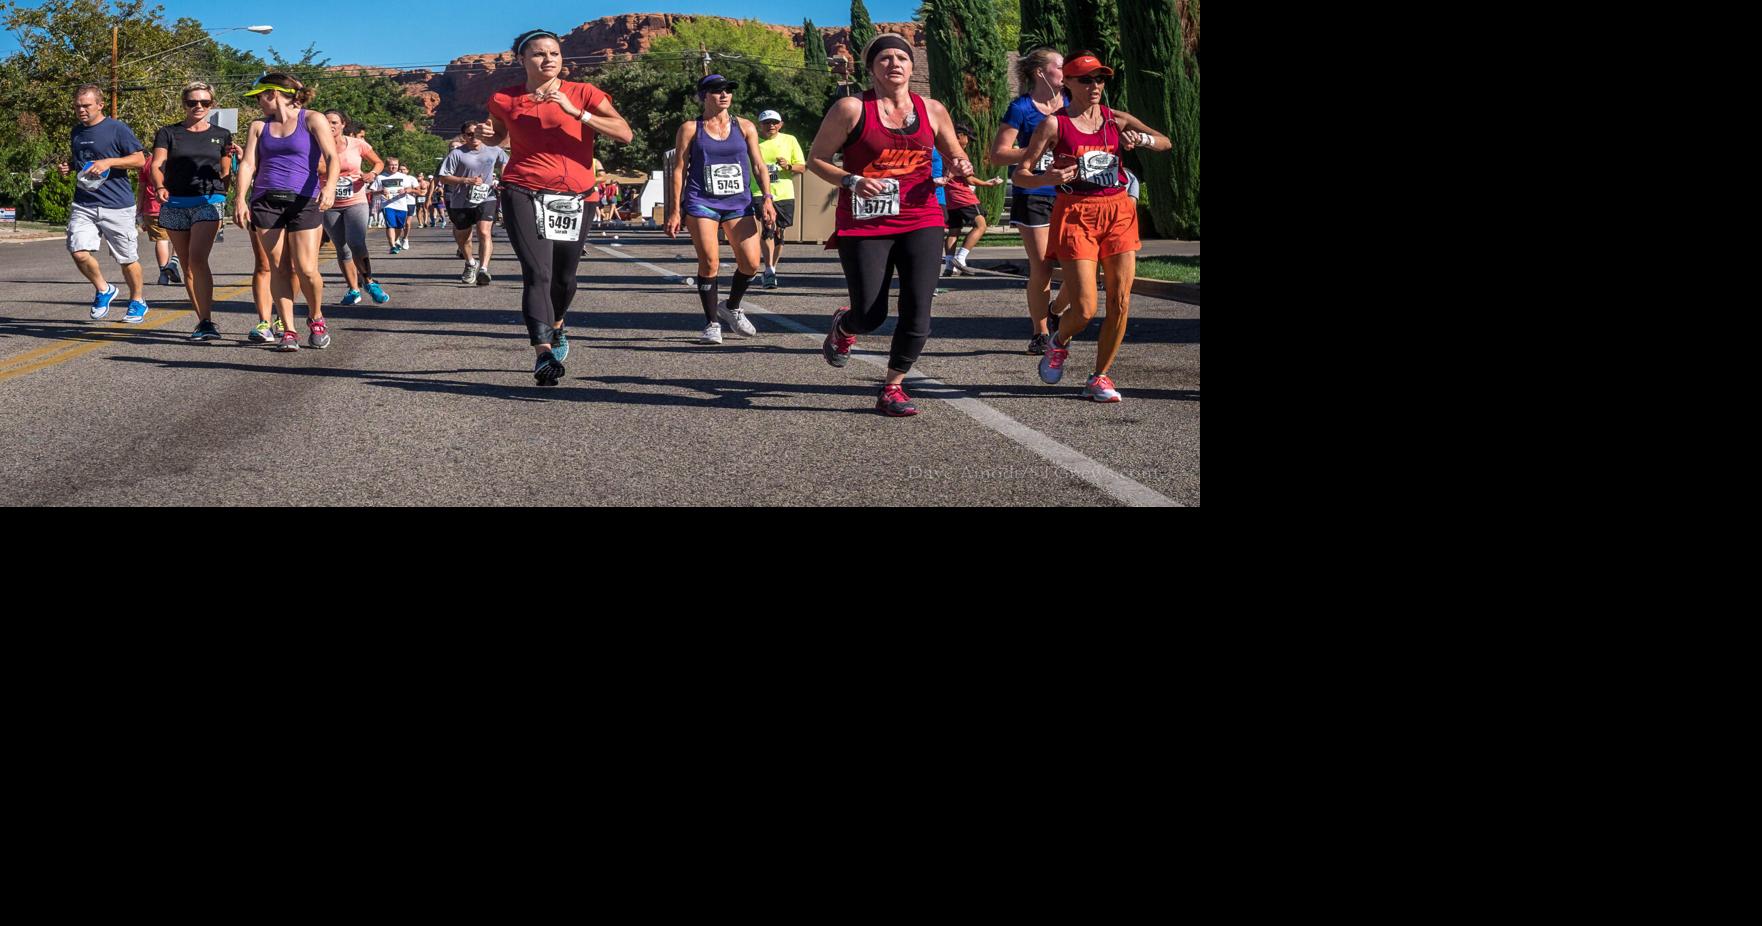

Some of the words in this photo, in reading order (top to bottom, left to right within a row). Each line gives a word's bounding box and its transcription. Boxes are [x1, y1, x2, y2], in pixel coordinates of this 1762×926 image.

[877, 149, 927, 166] NIKE
[717, 179, 740, 190] 5745
[864, 199, 894, 215] 5771
[548, 215, 578, 231] 5491
